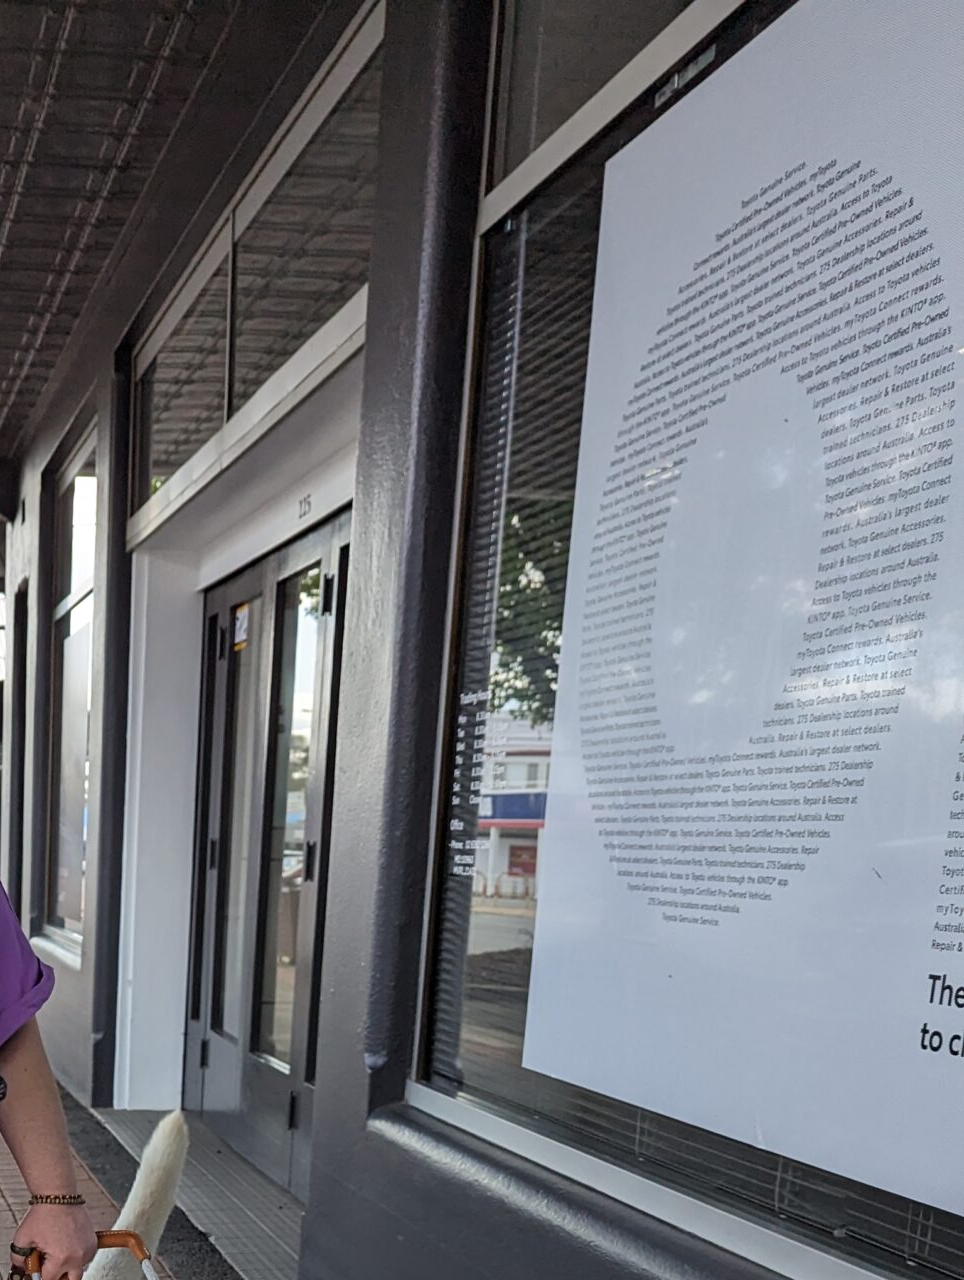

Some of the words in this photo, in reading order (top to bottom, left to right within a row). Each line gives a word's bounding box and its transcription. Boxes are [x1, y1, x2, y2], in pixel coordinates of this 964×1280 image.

[873, 401, 904, 419] Genne
[931, 939, 956, 952] Repair
[928, 973, 964, 1009] The
[920, 1022, 943, 1053] to
